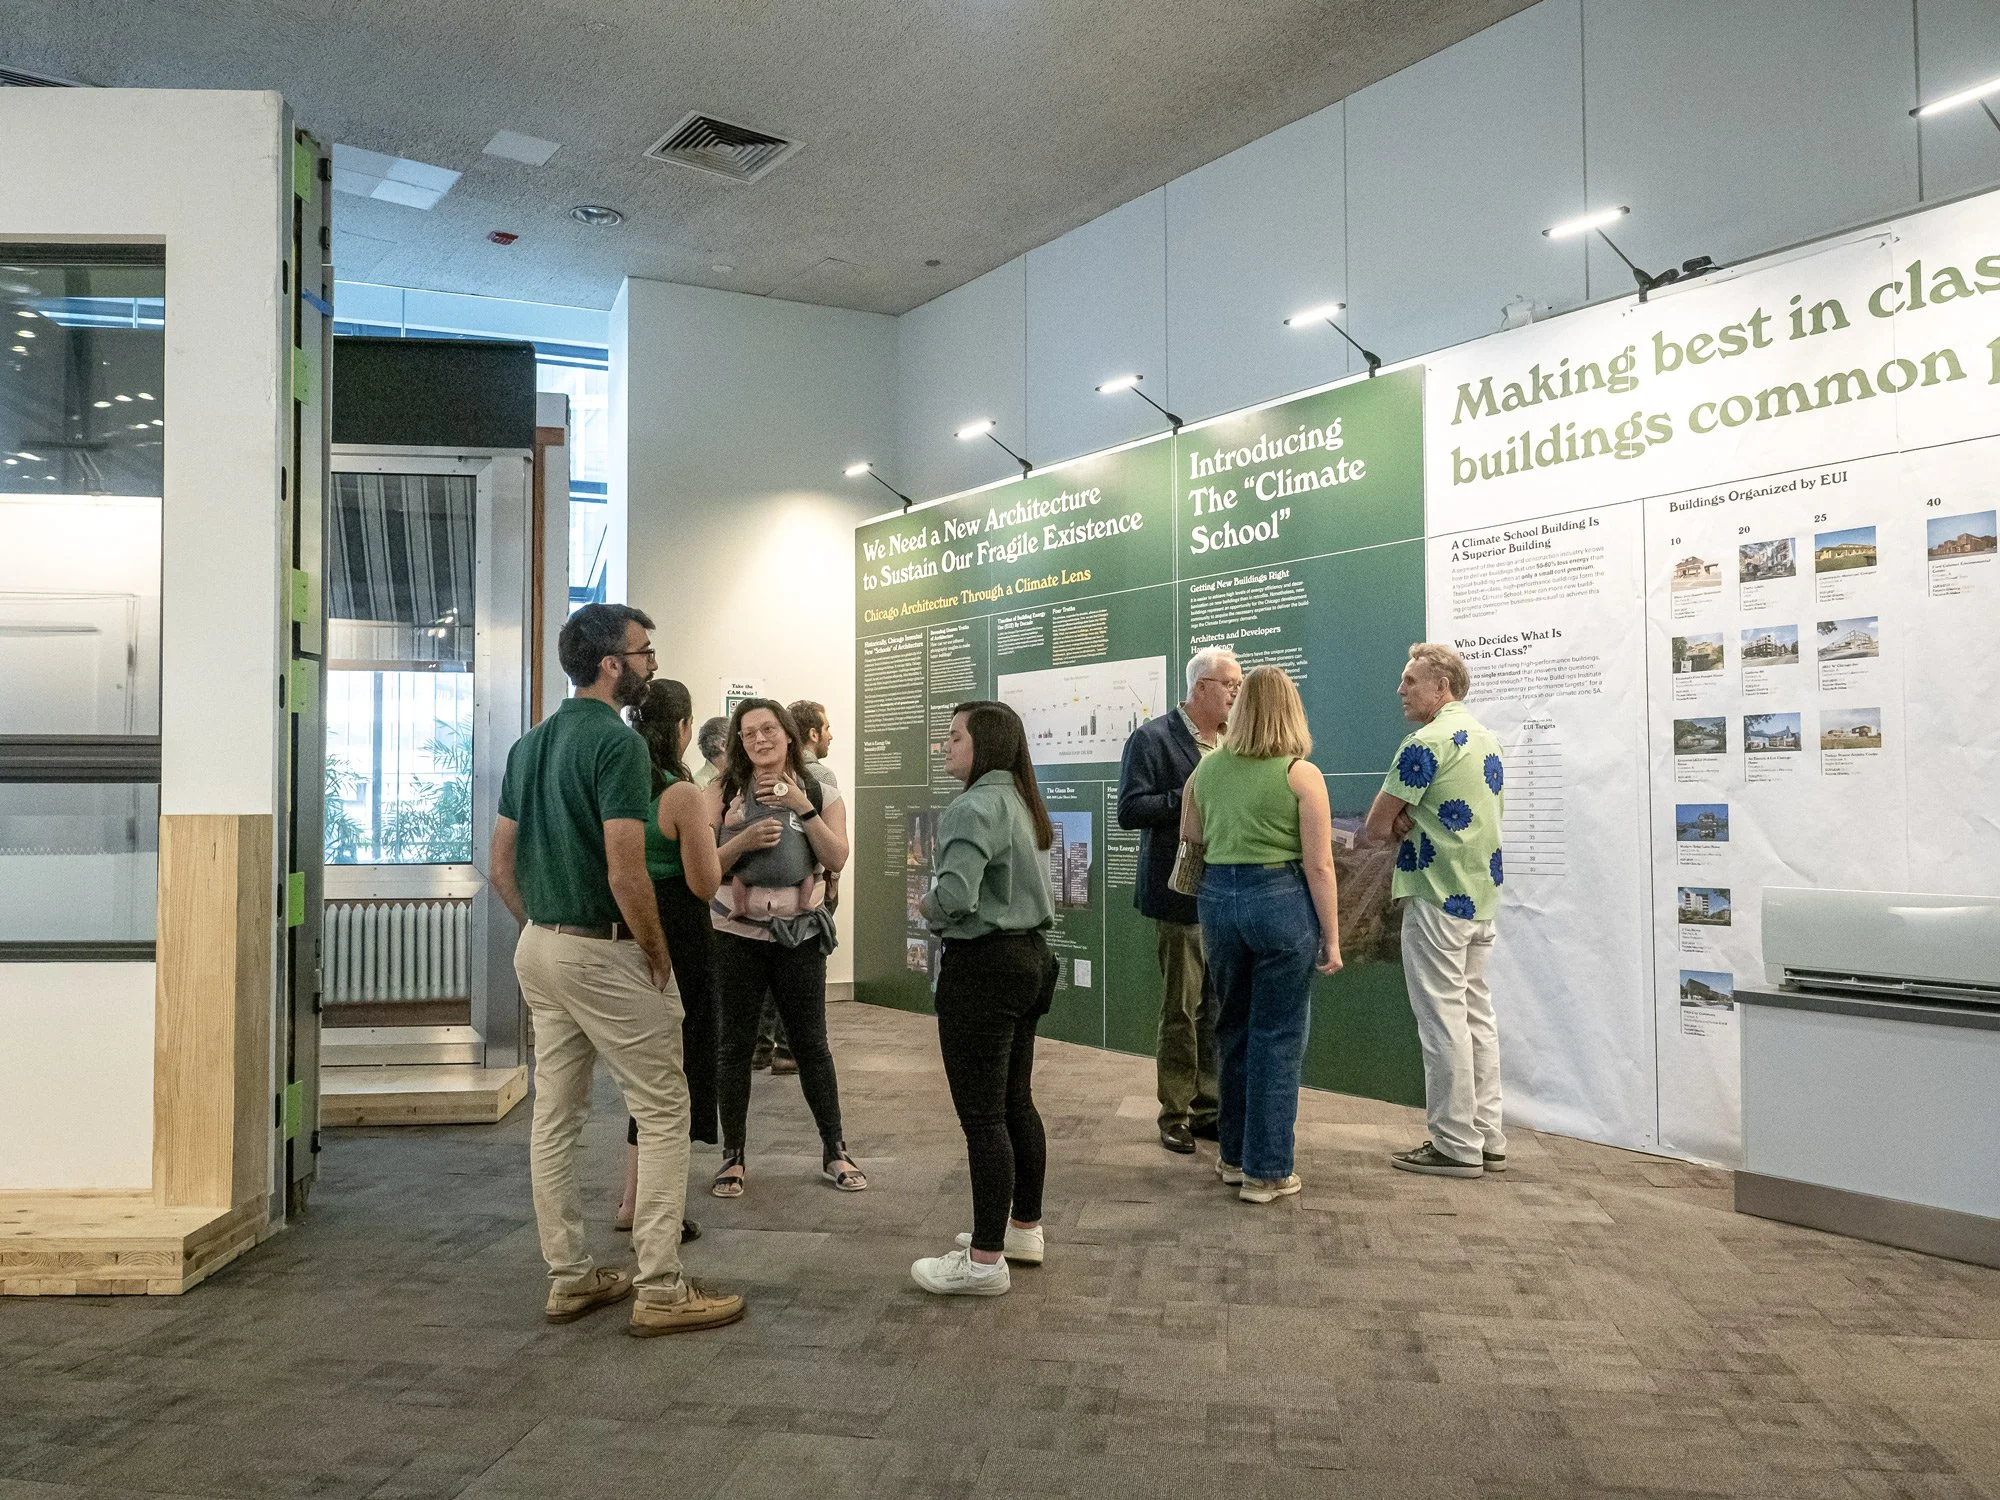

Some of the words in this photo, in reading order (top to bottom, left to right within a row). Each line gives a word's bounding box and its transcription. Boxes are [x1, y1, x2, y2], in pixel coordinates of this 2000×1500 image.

[1451, 345, 1638, 425] Making
[1652, 306, 1772, 375] best
[1788, 295, 1850, 340] in
[1868, 254, 2000, 321] clas
[1451, 410, 1673, 486] buildings
[1688, 343, 1967, 435] common
[1190, 417, 1343, 480] Introducing
[1188, 486, 1238, 516] The
[1245, 457, 1366, 501] “Climate
[1670, 494, 1725, 512] Buildings
[1729, 480, 1797, 503] Organized
[1801, 477, 1816, 490] by
[1821, 471, 1848, 486] EUI
[1926, 497, 1941, 507] 40
[863, 541, 885, 562] We
[889, 530, 927, 552] Need
[931, 531, 940, 545] a
[944, 518, 980, 542] New
[985, 486, 1101, 528] Architecture
[1190, 508, 1291, 554] School”
[1452, 540, 1459, 550] A
[1462, 535, 1500, 549] Climate
[1503, 527, 1538, 541] School
[1542, 518, 1585, 534] Building
[1589, 517, 1599, 526] Is
[1738, 525, 1750, 535] 20
[1814, 514, 1827, 523] 25
[863, 574, 877, 590] to
[880, 558, 938, 588] Sustain
[942, 550, 973, 573] Our
[977, 536, 1039, 565] Fragile
[1043, 510, 1144, 551] Existence
[1452, 553, 1459, 562] A
[1462, 544, 1506, 561] Superior
[1509, 538, 1551, 554] Building
[1670, 537, 1681, 546] 10
[864, 607, 899, 623] Chicago
[901, 594, 959, 617] Architecture
[961, 585, 1004, 606] Through
[1006, 585, 1013, 595] a
[1015, 575, 1059, 594] Climate
[1062, 567, 1091, 584] Lens
[1191, 584, 1215, 593] Getting
[1234, 574, 1267, 585] Buildings
[1269, 570, 1289, 580] Right
[1191, 632, 1224, 643] Architects
[1226, 630, 1239, 638] and
[1241, 626, 1281, 637] Developers
[1455, 639, 1476, 648] Who
[1479, 635, 1518, 645] Decides
[1521, 631, 1549, 641] What
[1552, 629, 1562, 637] Is
[1459, 645, 1532, 660] Best-in-Class?”
